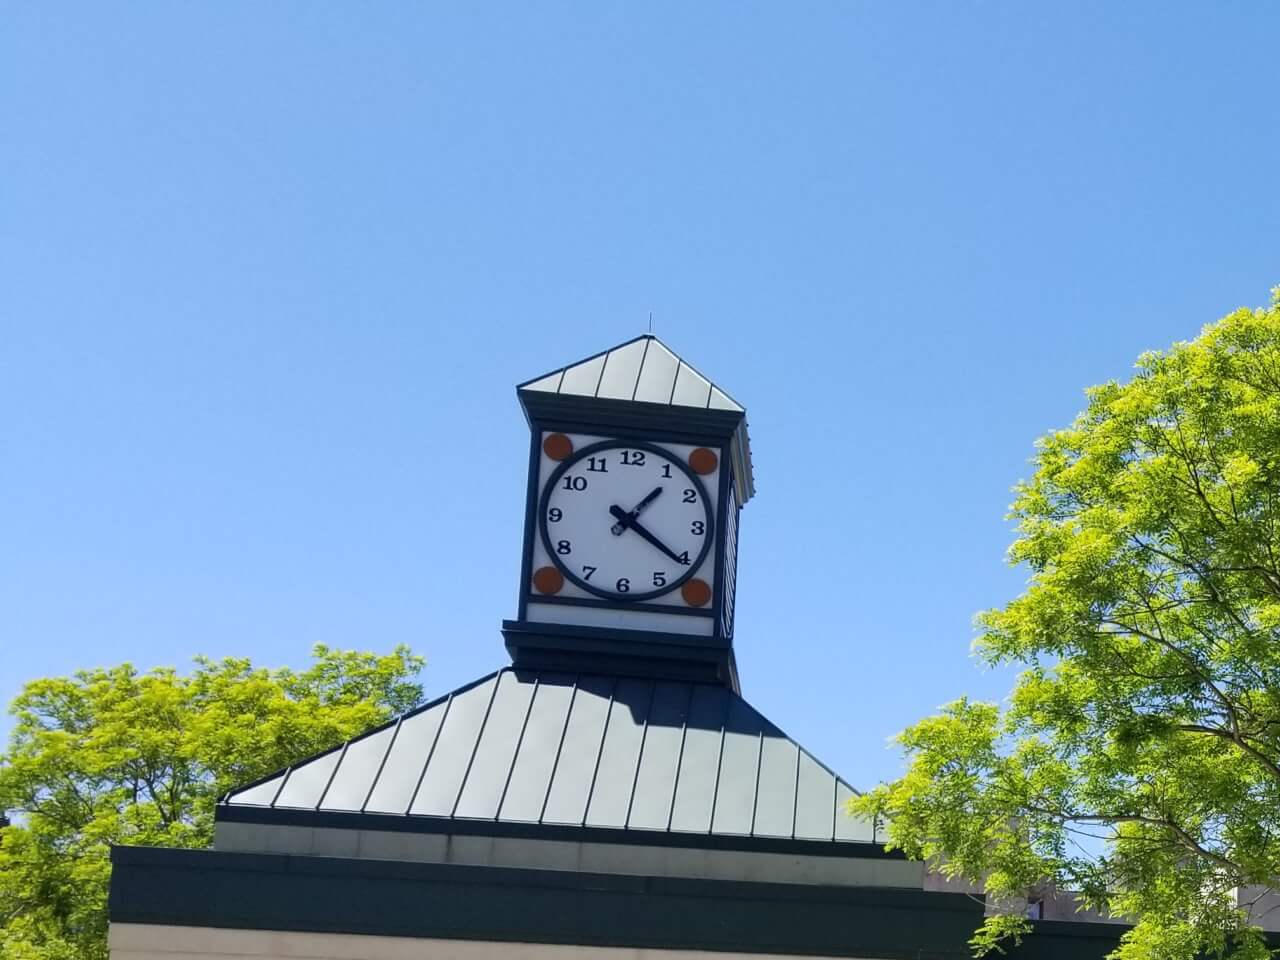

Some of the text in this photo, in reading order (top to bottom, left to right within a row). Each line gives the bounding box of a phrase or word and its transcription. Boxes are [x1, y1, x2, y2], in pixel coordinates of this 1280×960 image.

[586, 457, 609, 473] 11
[620, 450, 646, 466] 12
[661, 464, 673, 478] 1
[562, 475, 588, 491] 10
[682, 489, 697, 504] 2
[548, 508, 563, 522] 9
[691, 521, 705, 536] 3
[556, 540, 572, 555] 8
[678, 551, 691, 566] 4
[582, 566, 597, 581] 7
[652, 572, 667, 587] 5
[616, 578, 630, 593] 6
